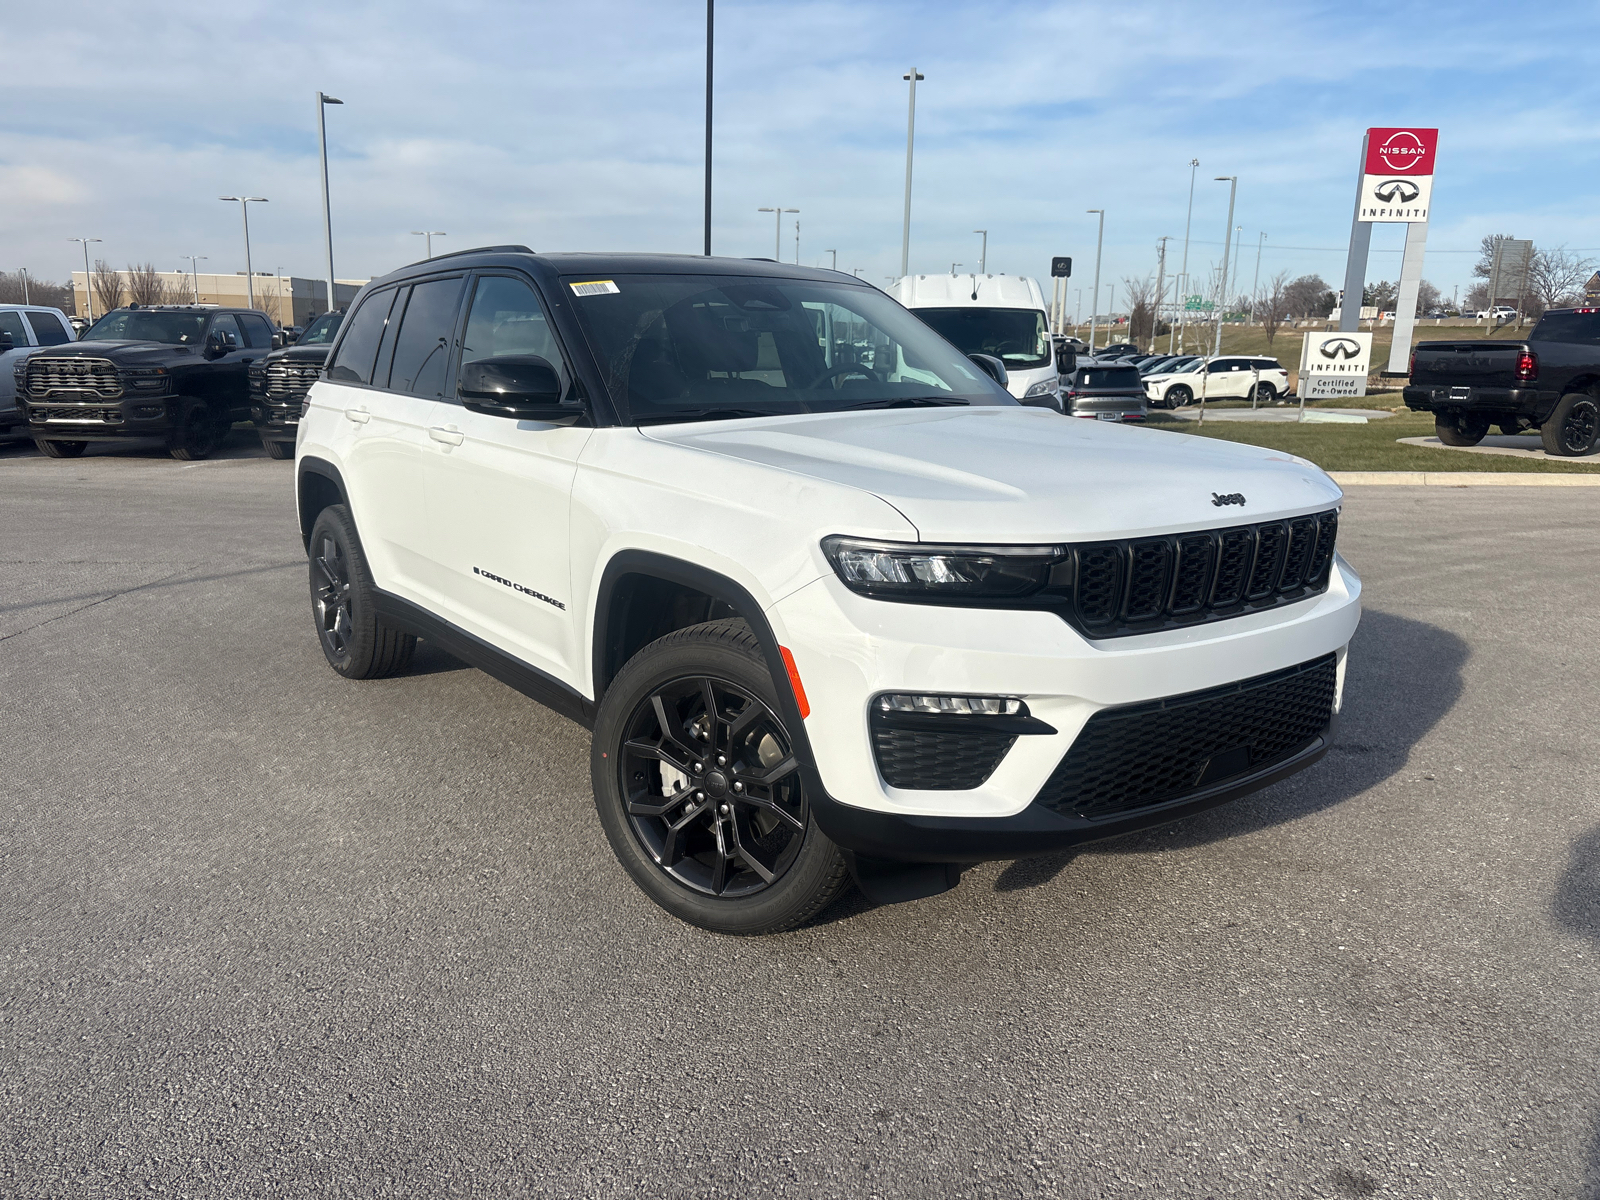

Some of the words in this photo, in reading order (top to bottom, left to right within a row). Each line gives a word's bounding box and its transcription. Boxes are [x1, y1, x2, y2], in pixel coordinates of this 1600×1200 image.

[1362, 208, 1426, 217] INFINITI
[1311, 364, 1365, 372] INFINITI
[1311, 387, 1358, 395] Pre-Owned
[1211, 492, 1247, 507] Jeep
[481, 570, 512, 587] GRAND
[513, 582, 566, 611] CHEROKEE
